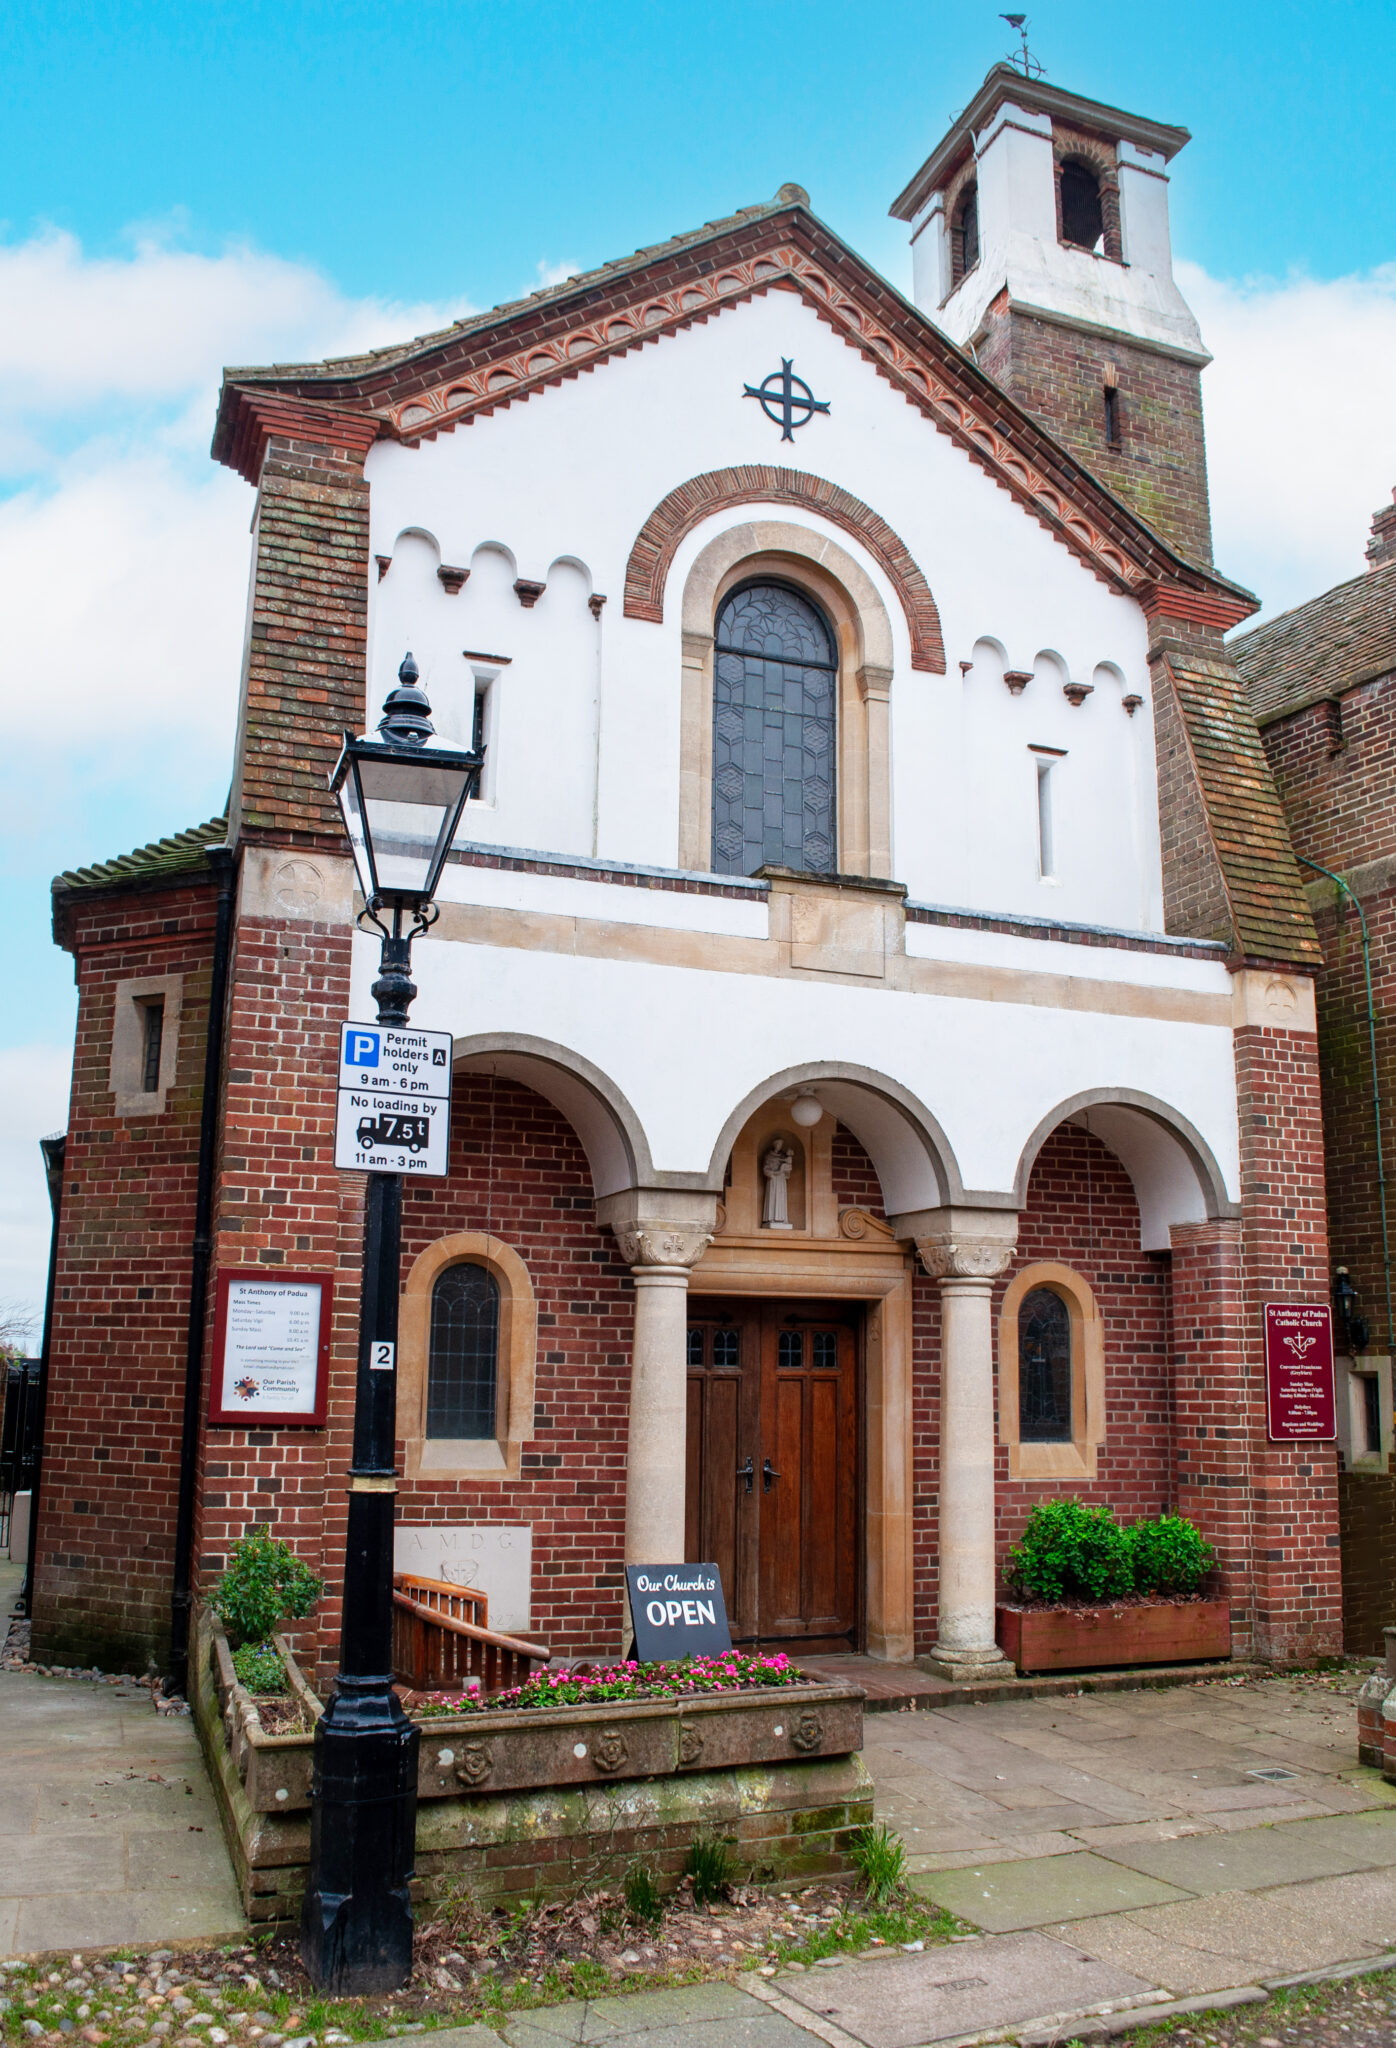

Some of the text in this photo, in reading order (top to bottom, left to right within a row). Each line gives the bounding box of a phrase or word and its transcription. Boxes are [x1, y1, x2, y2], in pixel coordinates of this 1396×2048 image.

[386, 1033, 428, 1048] Permit
[353, 1035, 375, 1063] P
[383, 1046, 429, 1060] holders
[434, 1051, 444, 1064] A
[392, 1062, 418, 1074] only
[360, 1074, 368, 1084] 9
[372, 1077, 390, 1087] am
[400, 1078, 408, 1088] 6
[410, 1080, 429, 1091] pm
[351, 1096, 437, 1116] No loading by
[355, 1153, 366, 1163] 11
[369, 1155, 387, 1165] am
[398, 1156, 406, 1167] 3
[409, 1158, 427, 1169] pm
[248, 1288, 277, 1296] Anthony
[1276, 1310, 1301, 1318] Anthony
[377, 1346, 390, 1364] 2
[636, 1574, 716, 1592] Our Church is
[646, 1600, 716, 1626] OPEN
